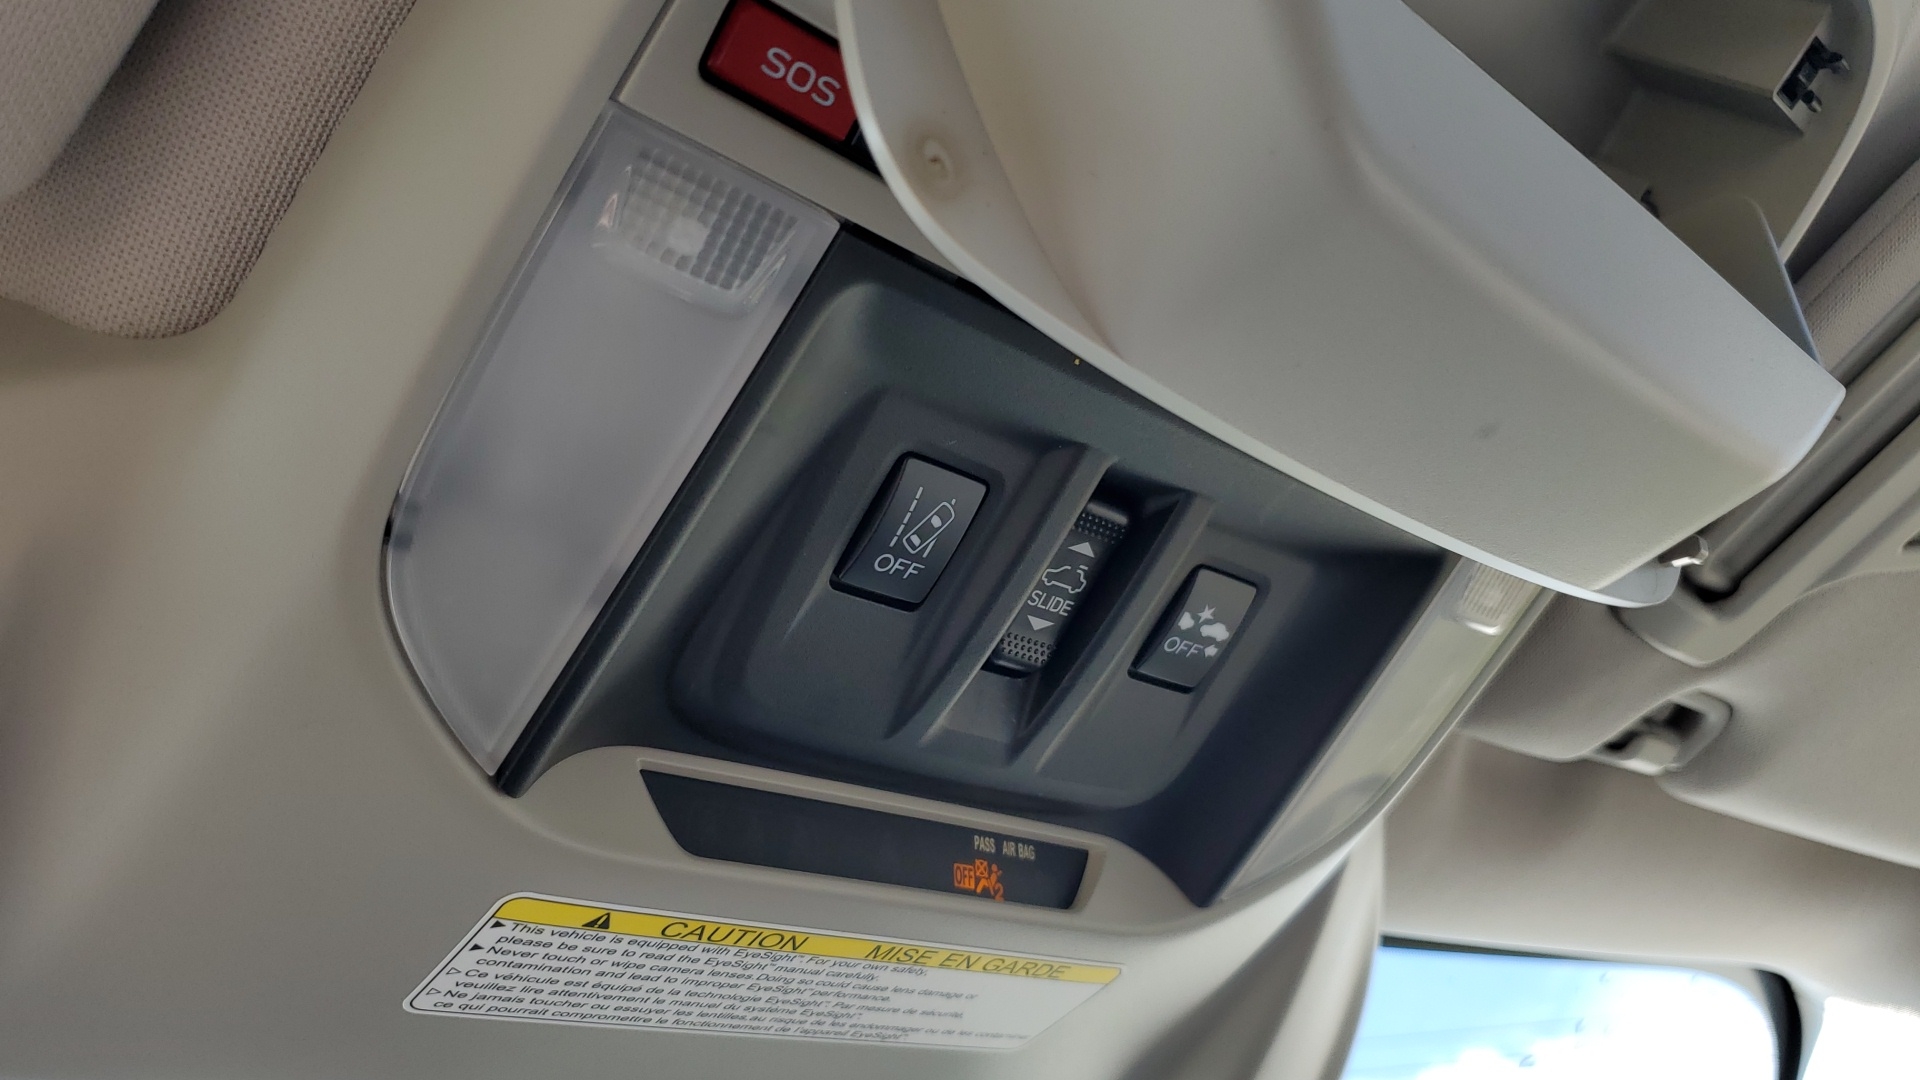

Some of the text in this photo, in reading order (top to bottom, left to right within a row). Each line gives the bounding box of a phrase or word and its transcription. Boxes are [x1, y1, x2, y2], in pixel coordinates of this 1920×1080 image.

[760, 47, 841, 107] SOS
[874, 553, 925, 580] OFF
[1027, 590, 1075, 617] SLIDE
[1164, 636, 1205, 659] OFF
[974, 835, 1036, 860] PASS AIR BAG
[955, 865, 974, 887] OFF
[495, 935, 553, 948] please
[557, 940, 578, 951] be
[582, 945, 617, 956] sure
[621, 949, 637, 957] to
[639, 952, 676, 961] read
[677, 954, 701, 964] the
[774, 964, 825, 977] manual
[511, 922, 545, 935] This
[551, 929, 606, 942] vehicle
[610, 935, 624, 944] is
[627, 938, 700, 952] equipped
[701, 946, 731, 956] with
[806, 956, 832, 965] For
[829, 959, 862, 969] your
[862, 962, 889, 971] own
[660, 922, 1072, 978] CAUTION MISE EN GARDE
[476, 958, 592, 976] contamination
[595, 970, 627, 979] and
[628, 972, 662, 982] lead
[664, 976, 679, 984] to
[681, 977, 745, 990] improper
[486, 946, 539, 959] Never
[542, 952, 586, 964] touch
[590, 958, 608, 966] or
[611, 960, 646, 970] wipe
[650, 964, 705, 976] camera
[756, 973, 795, 985] Doing
[816, 980, 853, 989] could
[852, 983, 889, 992] cause
[891, 986, 916, 994] lens
[455, 980, 517, 992] veuillez
[520, 986, 544, 994] lire
[548, 988, 651, 1004] attentivement
[652, 997, 666, 1005] le
[669, 1000, 722, 1009] manuel
[723, 1002, 741, 1010] du
[465, 969, 489, 978] Ce
[495, 972, 560, 985] véhicule
[564, 980, 589, 988] est
[592, 980, 643, 993] équipé
[646, 986, 665, 994] de
[668, 988, 681, 996] la
[684, 990, 762, 1003] technologie
[832, 1001, 856, 1009] Par
[856, 1004, 902, 1013] mesure
[443, 990, 468, 999] Ne
[469, 991, 524, 1004] jamais
[530, 997, 588, 1009] toucher
[614, 1004, 671, 1015] essuyer
[673, 1008, 694, 1017] les
[771, 1015, 808, 1025] risque
[459, 1003, 486, 1011] qui
[486, 1004, 549, 1016] pourrait
[551, 1009, 652, 1023] compromettre
[672, 1018, 774, 1032] fonctionnement
[774, 1024, 791, 1032] de
